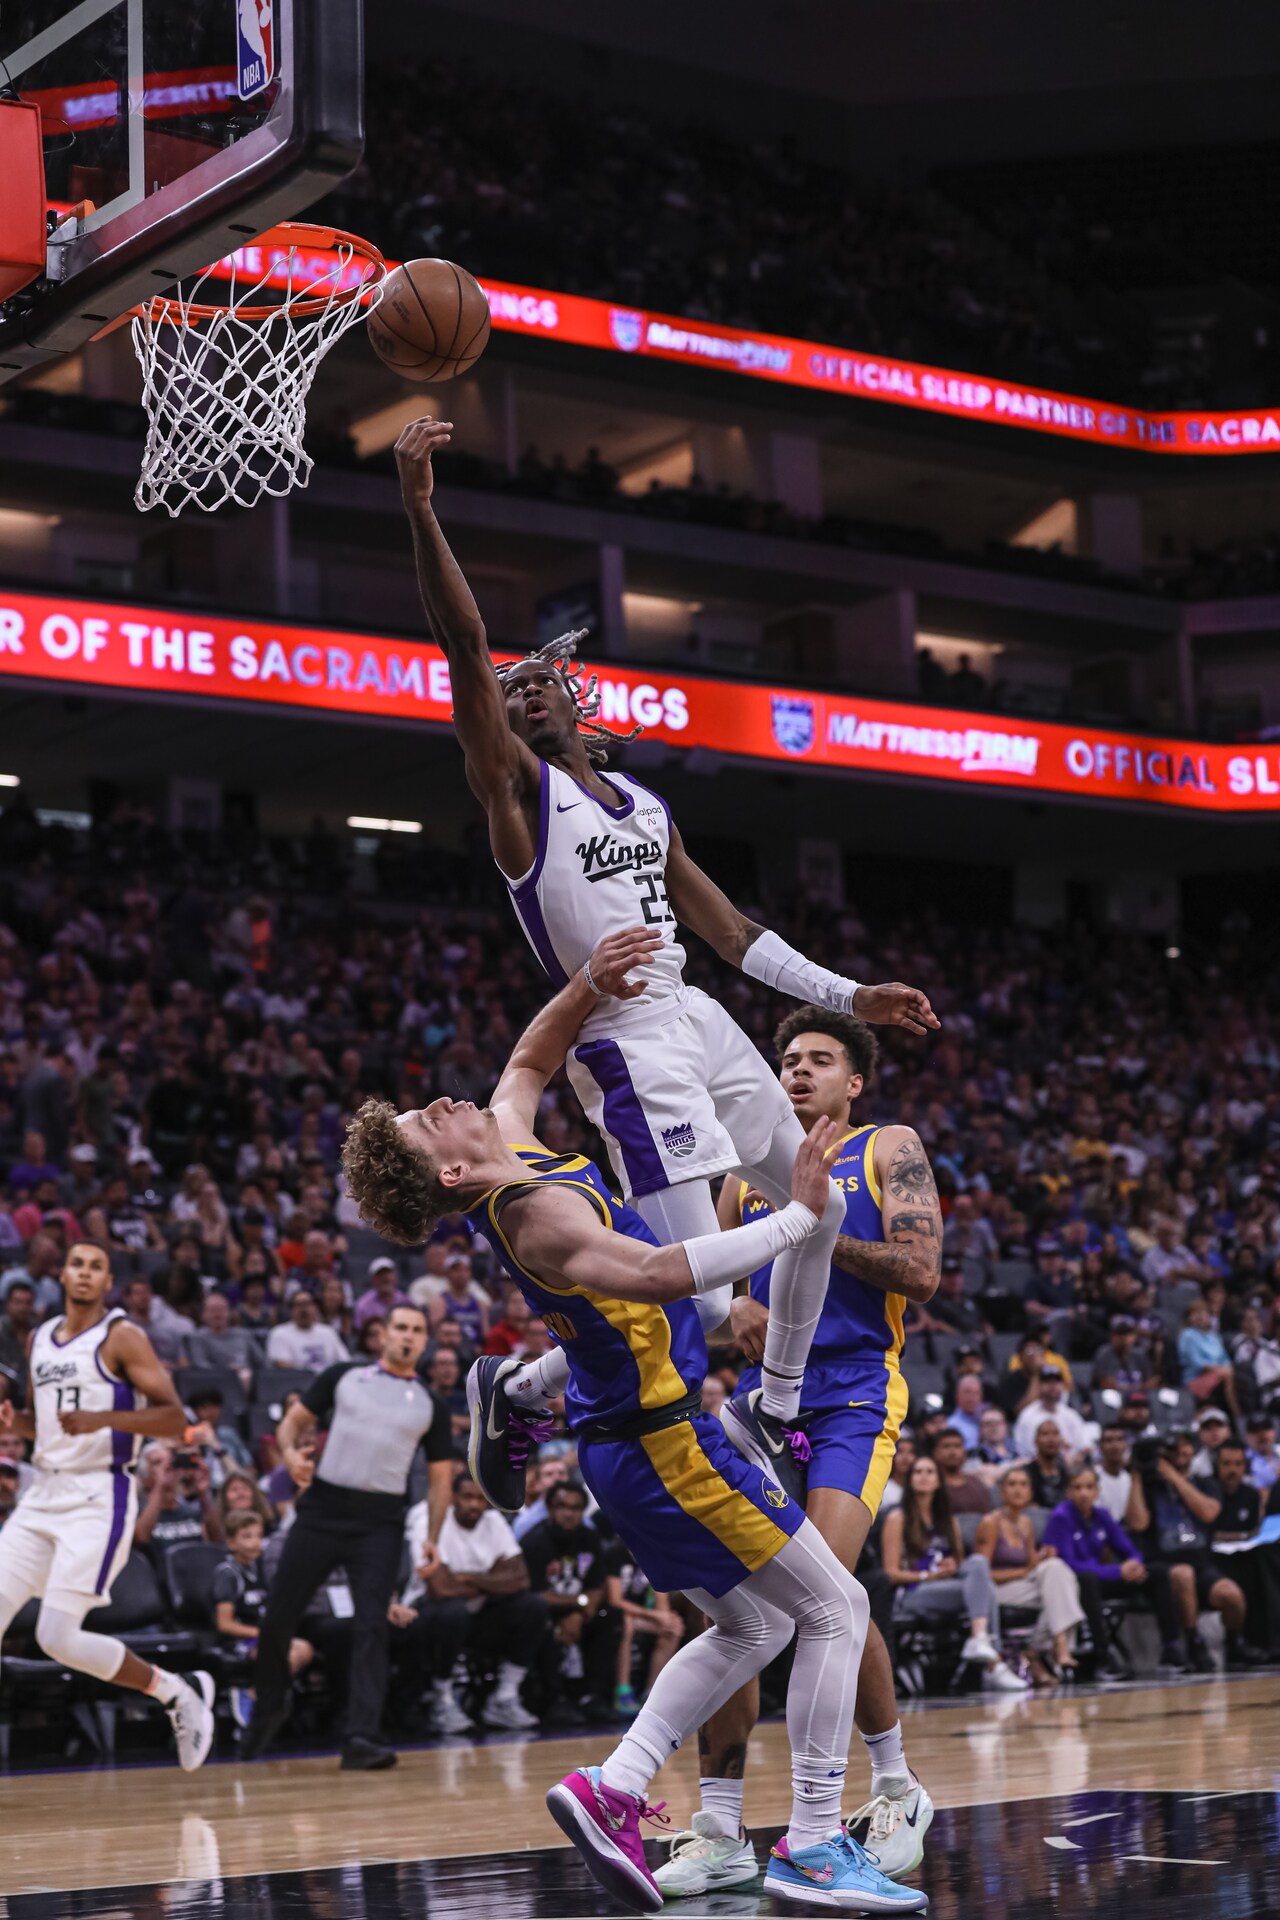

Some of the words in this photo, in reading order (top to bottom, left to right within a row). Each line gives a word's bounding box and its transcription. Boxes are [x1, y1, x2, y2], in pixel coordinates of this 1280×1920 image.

[243, 60, 260, 90] NBA
[486, 289, 558, 329] INGS
[810, 353, 919, 397] OFFICIAL
[920, 374, 992, 409] SLEEP
[994, 388, 1095, 430] PARTNER
[1100, 411, 1129, 435] OF
[1135, 416, 1176, 443] THE
[40, 614, 109, 662] OF
[119, 622, 215, 675] THE
[1065, 738, 1217, 794] OFFICIAL
[575, 834, 662, 884] Kings
[665, 1133, 695, 1150] KINGS
[36, 1361, 77, 1387] Kings
